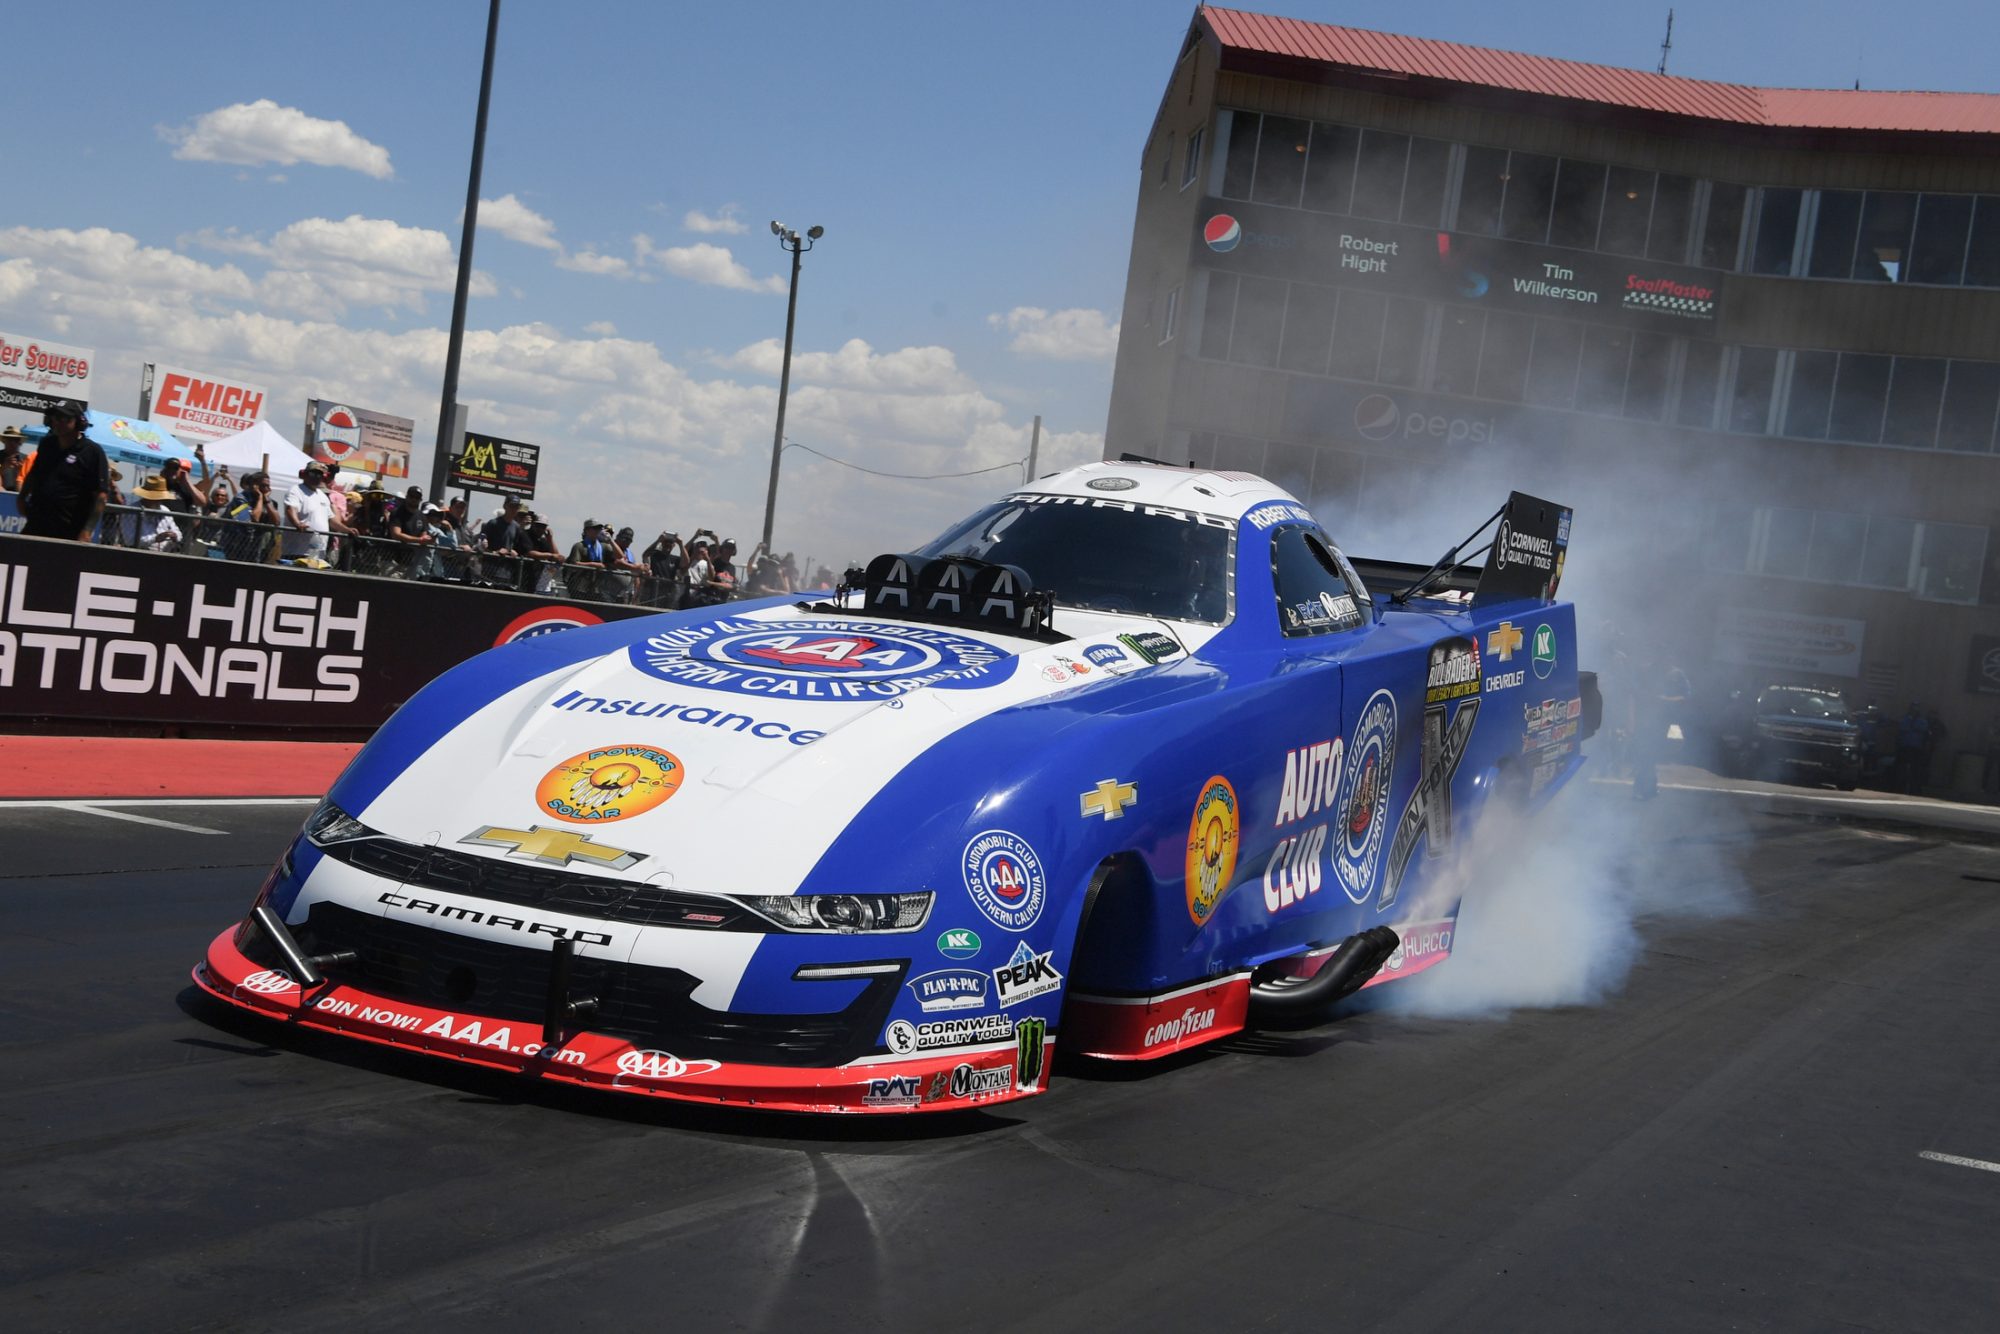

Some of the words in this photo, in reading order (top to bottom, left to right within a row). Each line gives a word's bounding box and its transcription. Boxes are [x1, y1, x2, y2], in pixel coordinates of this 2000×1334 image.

[1339, 235, 1398, 256] Robert
[1341, 254, 1388, 273] Hight
[1543, 263, 1574, 281] Tim
[1513, 278, 1598, 303] Wilkerson
[1626, 274, 1713, 300] SealMaster
[25, 343, 89, 379] Source
[155, 373, 263, 419] EMICH
[186, 410, 251, 430] CHEVROLET
[1403, 412, 1496, 444] pepsi
[1246, 505, 1294, 530] ROBERT
[1511, 532, 1553, 556] CORNWELL
[1508, 550, 1532, 566] QUALITY
[1533, 555, 1551, 570] TOOLS
[713, 620, 965, 645] AUTOMOBILE
[741, 635, 908, 667] AAA
[1486, 671, 1524, 692] CHEVROLET
[551, 690, 828, 746] Insurance
[1348, 702, 1390, 780] AUTOMOBILE
[588, 746, 676, 772] POWERS
[1420, 711, 1466, 807] FORCE
[1275, 736, 1344, 828] AUTO
[546, 798, 621, 820] SOLAR
[1197, 783, 1235, 824] POWERS
[1358, 781, 1388, 889] CALIFORNIA
[968, 835, 1014, 872] AUTOMOBILE
[1015, 843, 1037, 869] CLUB
[990, 865, 1025, 889] AAA
[1263, 825, 1328, 913] CLUB
[970, 877, 1013, 926] SOUTHERN
[1014, 875, 1042, 926] CALIFORNIA
[377, 892, 613, 946] CAMARO
[1405, 931, 1450, 958] HURCO
[246, 969, 292, 993] AAA
[996, 956, 1057, 996] PEAK
[1001, 990, 1028, 1007] ANTIFREEZE
[1034, 982, 1059, 996] COOLANT
[305, 995, 353, 1016] JOIN
[357, 1006, 422, 1031] NOW!
[422, 1015, 586, 1066] AAA.com
[918, 1016, 1010, 1036] CORNWELL
[918, 1032, 972, 1046] QUALITY
[977, 1027, 1010, 1039] TOOLS
[622, 1050, 679, 1078] AAA
[870, 1076, 920, 1096] RMT
[951, 1066, 1010, 1097] MONTANA
